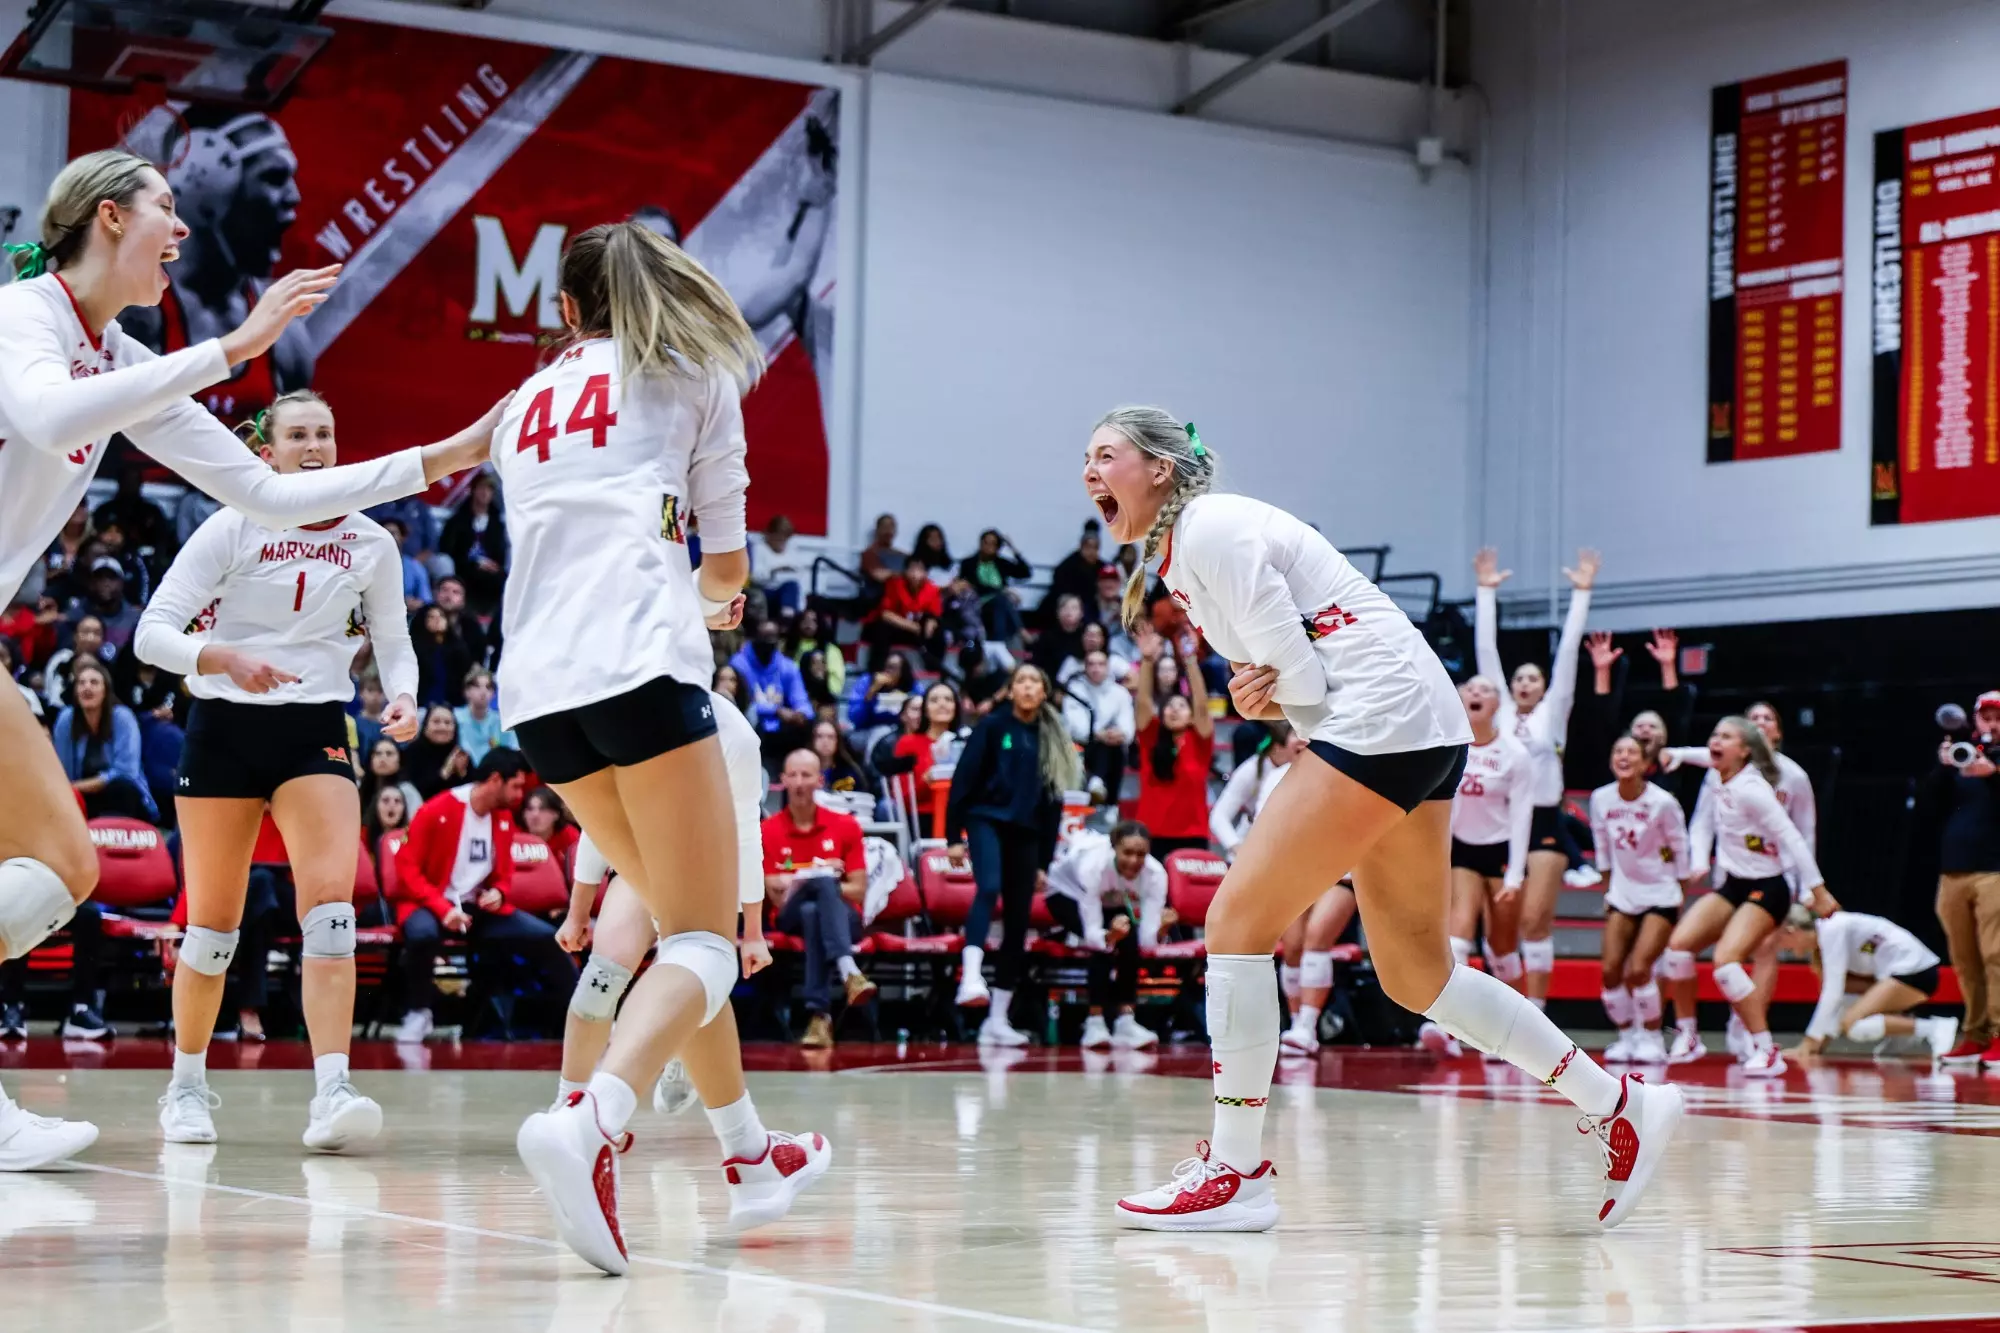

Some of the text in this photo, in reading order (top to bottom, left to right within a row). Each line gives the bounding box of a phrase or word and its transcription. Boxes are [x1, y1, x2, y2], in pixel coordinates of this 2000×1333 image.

[315, 63, 508, 260] WRESTLING
[469, 214, 568, 330] M
[1874, 178, 1902, 356] WRESTLING
[517, 373, 619, 463] 44
[259, 541, 352, 570] MARYLAND
[293, 571, 306, 612] 1
[1459, 773, 1484, 797] 26
[88, 828, 158, 850] MARYLAND
[1614, 826, 1638, 850] 24
